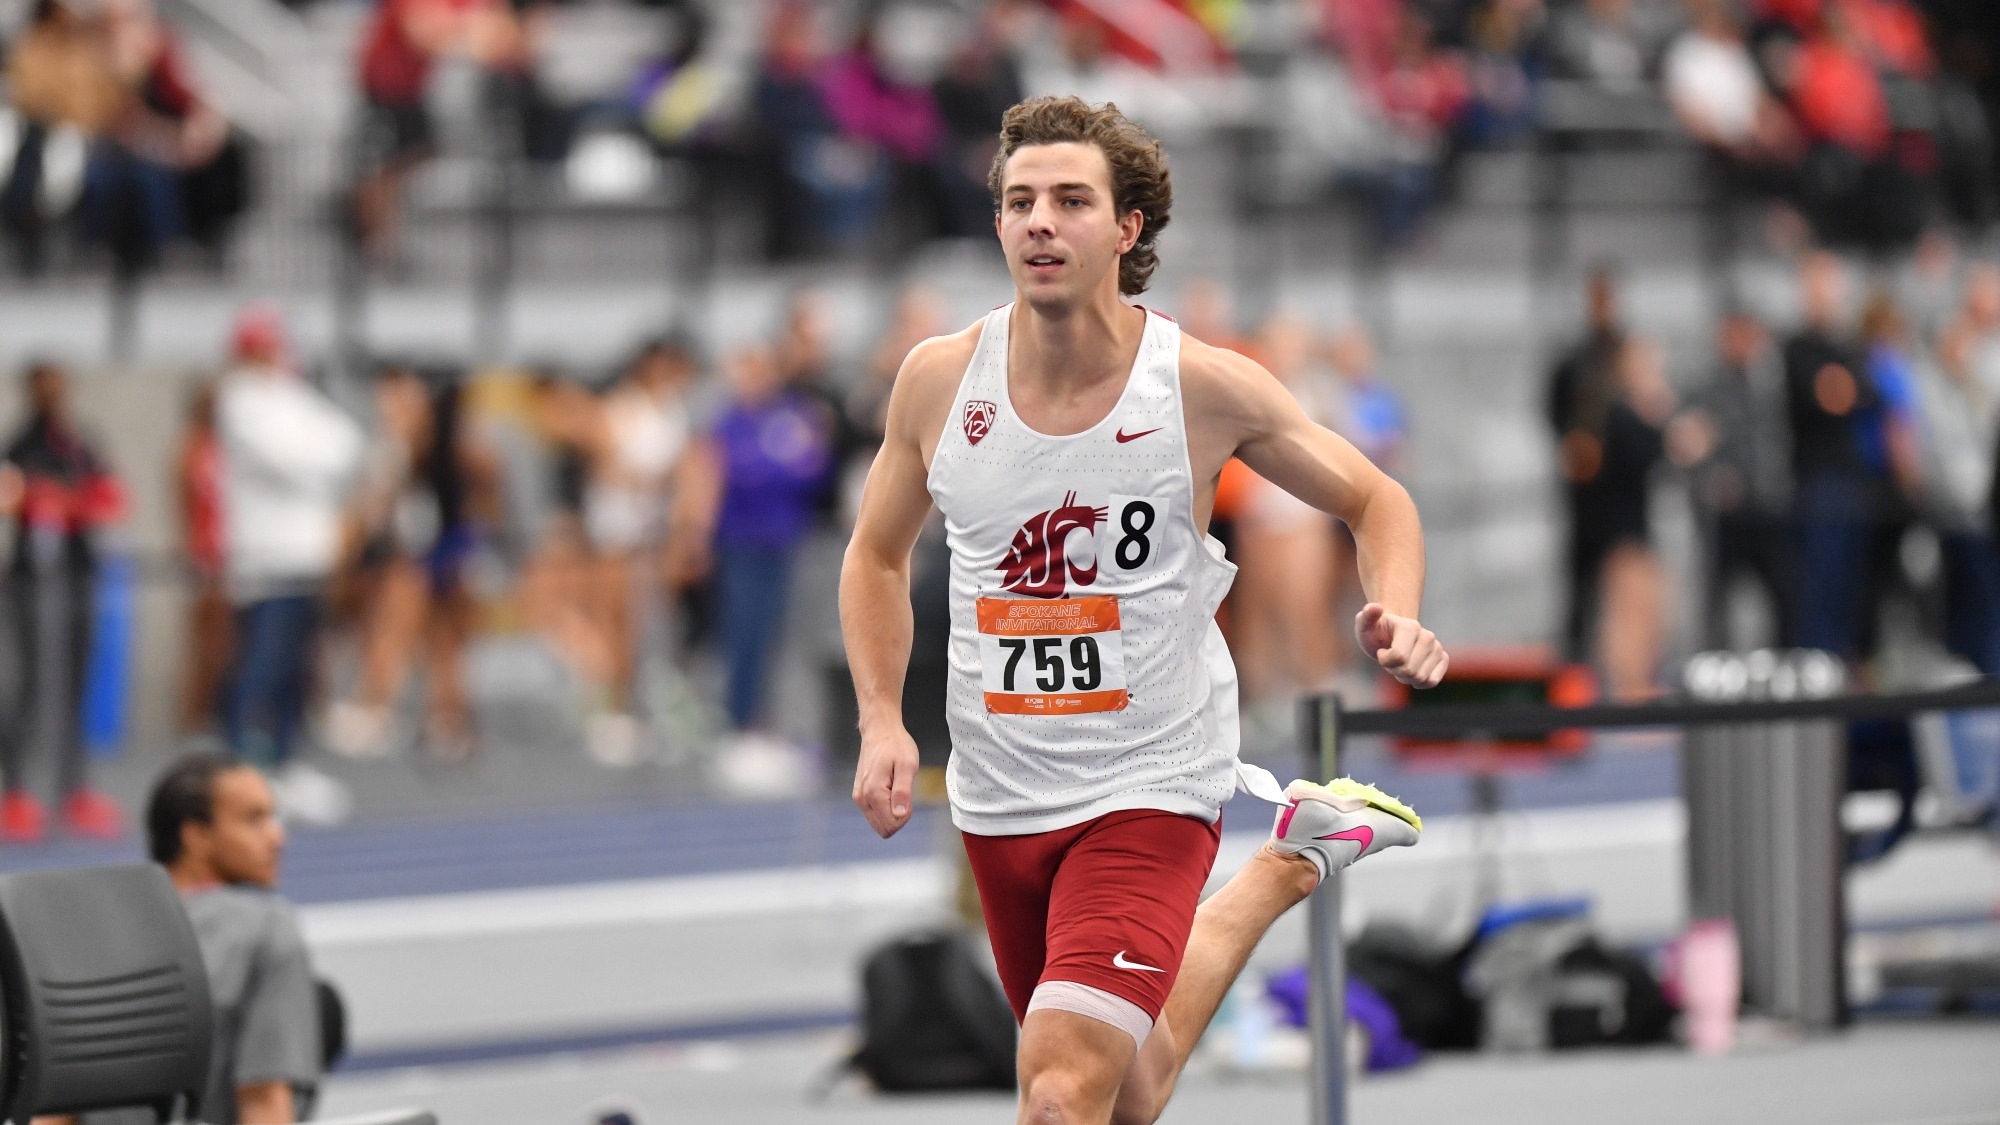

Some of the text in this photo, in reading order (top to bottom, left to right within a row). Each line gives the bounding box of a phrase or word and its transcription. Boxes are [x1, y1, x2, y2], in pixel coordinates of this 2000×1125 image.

[964, 401, 996, 429] PAC
[968, 420, 985, 438] 12
[1115, 501, 1155, 570] 8
[1008, 604, 1082, 618] SPOKANE
[995, 616, 1099, 631] INVITATIONAL
[998, 636, 1102, 693] 759
